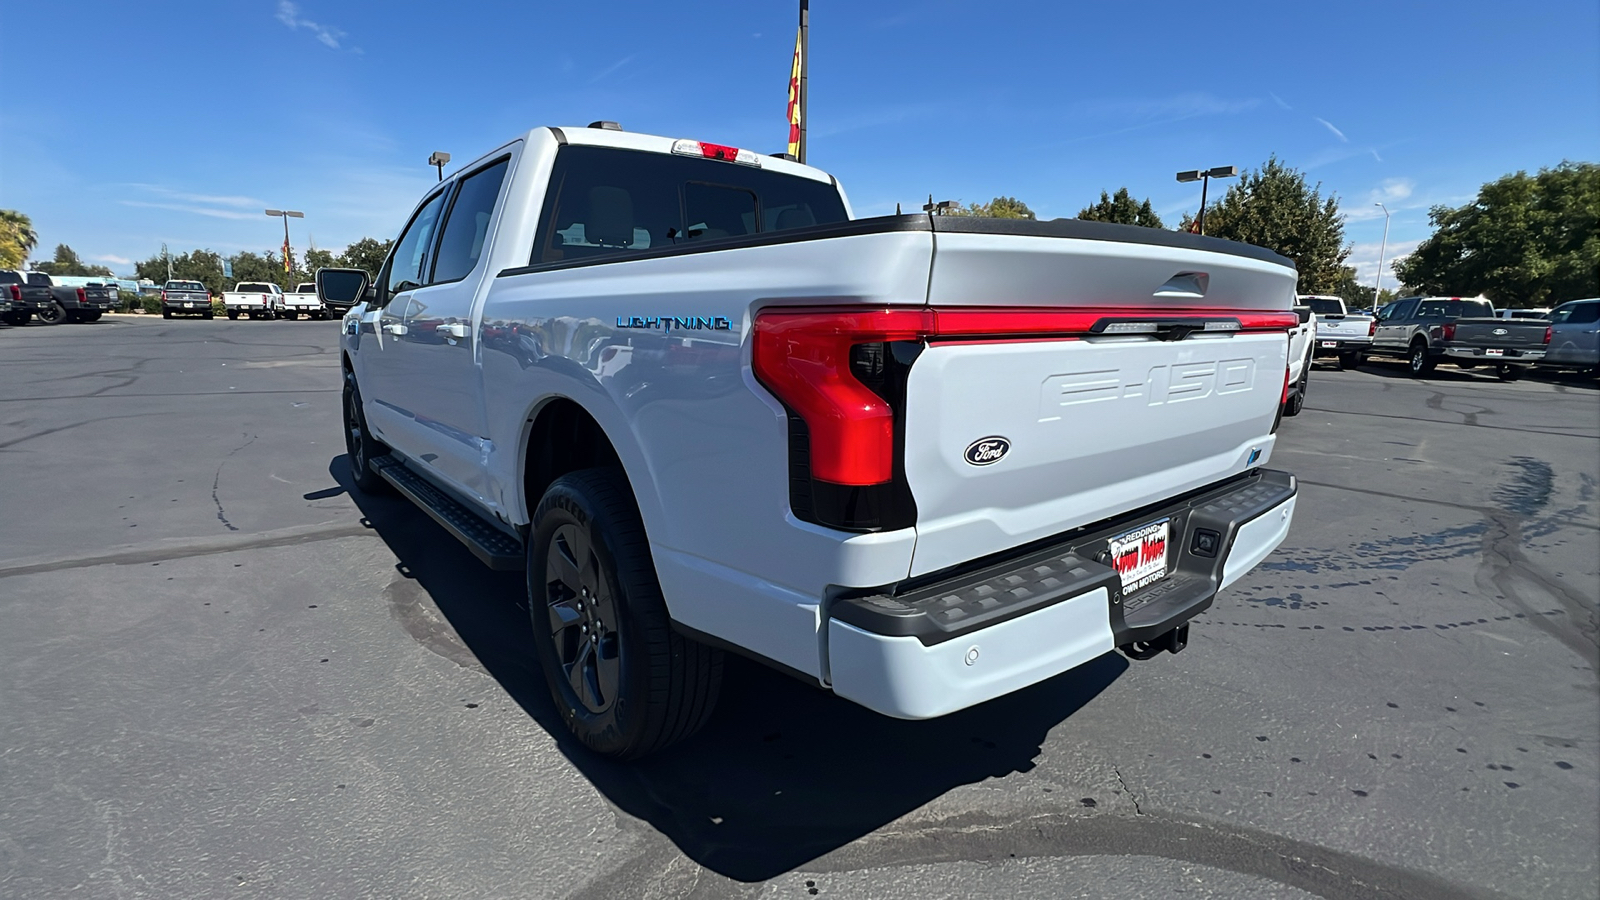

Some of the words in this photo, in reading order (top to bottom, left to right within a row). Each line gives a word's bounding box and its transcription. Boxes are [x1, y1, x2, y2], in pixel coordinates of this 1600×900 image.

[616, 316, 733, 334] LIGHTNING
[1037, 357, 1256, 423] F-150
[1125, 524, 1158, 543] REDDING
[1122, 581, 1138, 596] OWN
[1139, 569, 1165, 588] MOTORS
